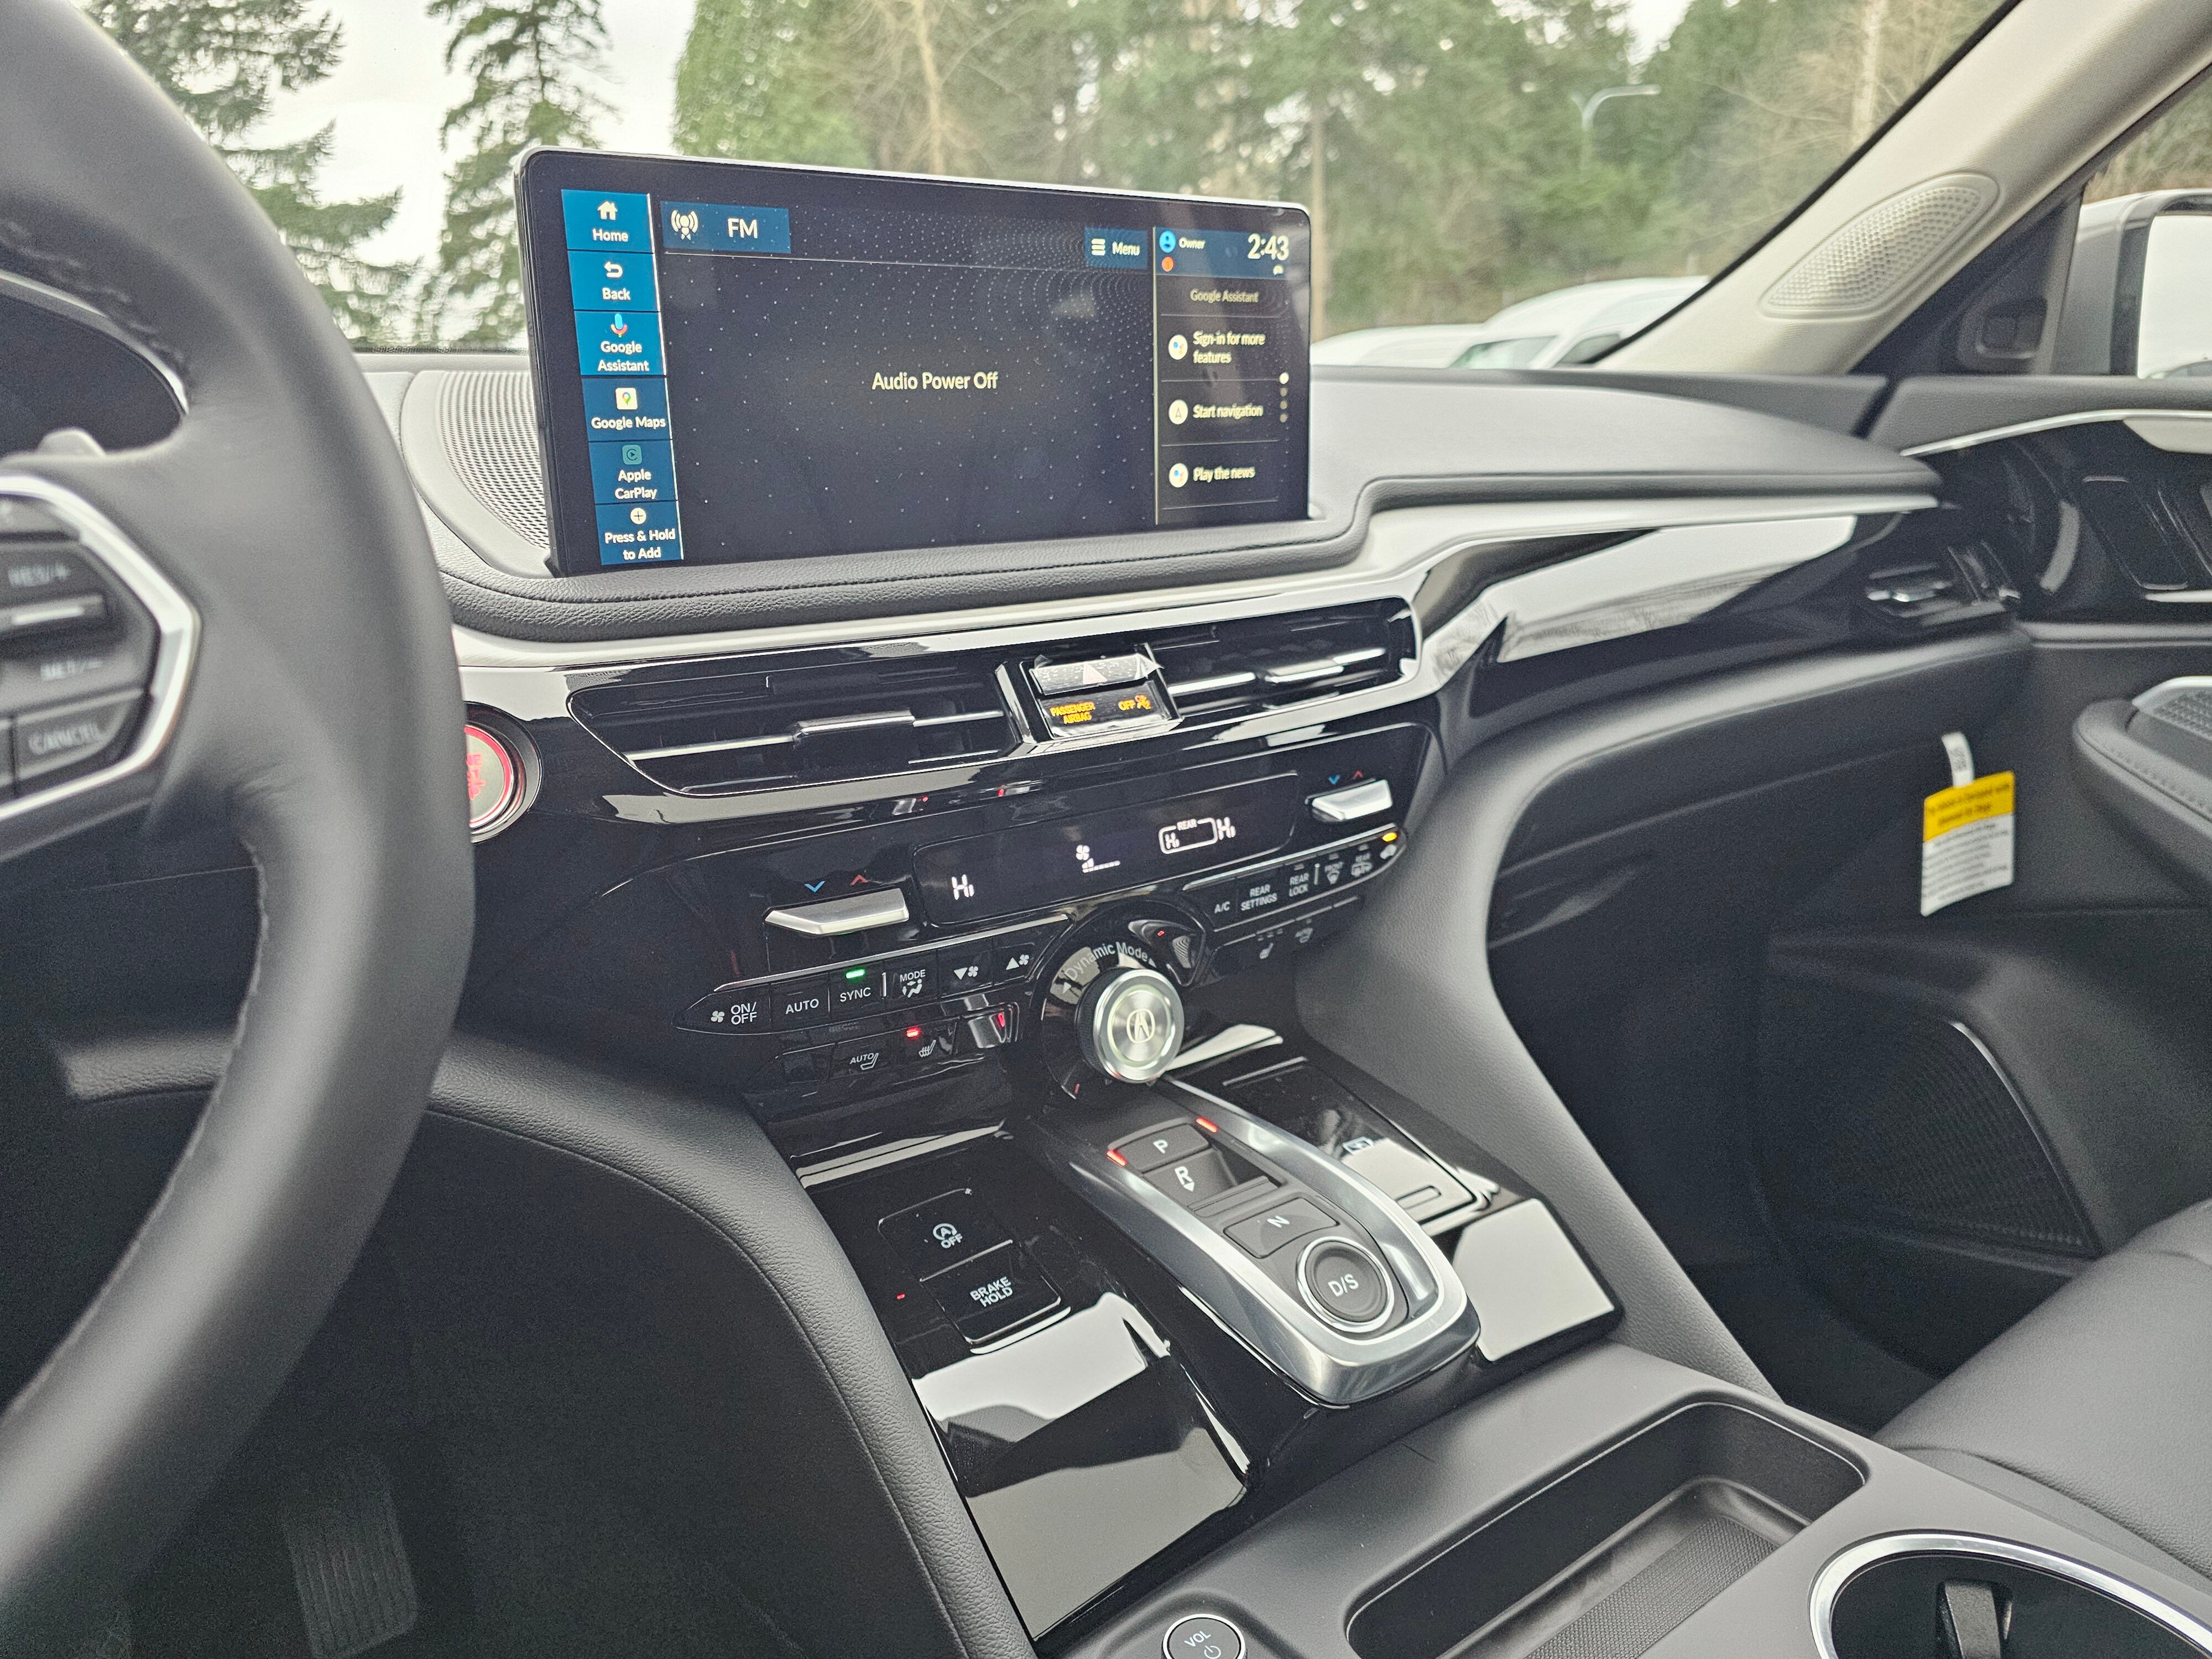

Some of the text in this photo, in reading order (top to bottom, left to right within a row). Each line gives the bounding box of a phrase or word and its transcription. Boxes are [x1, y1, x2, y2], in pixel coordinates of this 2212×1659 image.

[592, 229, 629, 242] Home
[727, 218, 758, 239] FM
[1112, 241, 1140, 257] Menu
[1178, 237, 1205, 249] Owner
[1247, 233, 1289, 260] 2:43
[602, 288, 631, 300] Back
[1190, 289, 1259, 304] Google Assistant
[1193, 331, 1266, 347] Sign-in for more
[600, 341, 642, 355] Google
[1193, 350, 1232, 364] features
[597, 359, 649, 372] Assistant
[872, 371, 998, 390] Audio Power Off
[1192, 403, 1264, 419] Start navigation
[591, 416, 666, 430] Google Maps
[618, 469, 651, 483] Apple
[1193, 466, 1256, 483] Play the news
[614, 488, 657, 501] CarPlay
[604, 529, 675, 544] Press & Hold
[623, 547, 661, 560] to Add
[1050, 701, 1096, 717] PASSENGER
[1118, 700, 1135, 711] OFF
[1063, 711, 1092, 724] AIRBAG
[1176, 818, 1197, 831] REAR
[1290, 873, 1309, 886] REAR
[1249, 884, 1270, 898] REAR
[1288, 884, 1309, 897] LOCK
[1214, 901, 1230, 914] A/C
[1240, 894, 1277, 911] SETTINGS
[1063, 941, 1148, 981] Dynamic Mode
[899, 969, 926, 982] MODE
[839, 987, 872, 1003] SYNC
[730, 1001, 757, 1015] ON/
[785, 998, 820, 1015] AUTO
[730, 1011, 758, 1026] OFF
[849, 1052, 875, 1065] AUTO
[1153, 1139, 1168, 1154] P
[1175, 1166, 1190, 1185] R
[1267, 1215, 1291, 1228] N
[941, 1233, 963, 1249] OFF
[969, 1276, 1011, 1301] BRAKE
[1328, 1274, 1359, 1297] D/S
[979, 1287, 1013, 1307] HOLD
[1184, 1631, 1211, 1647] VOL
